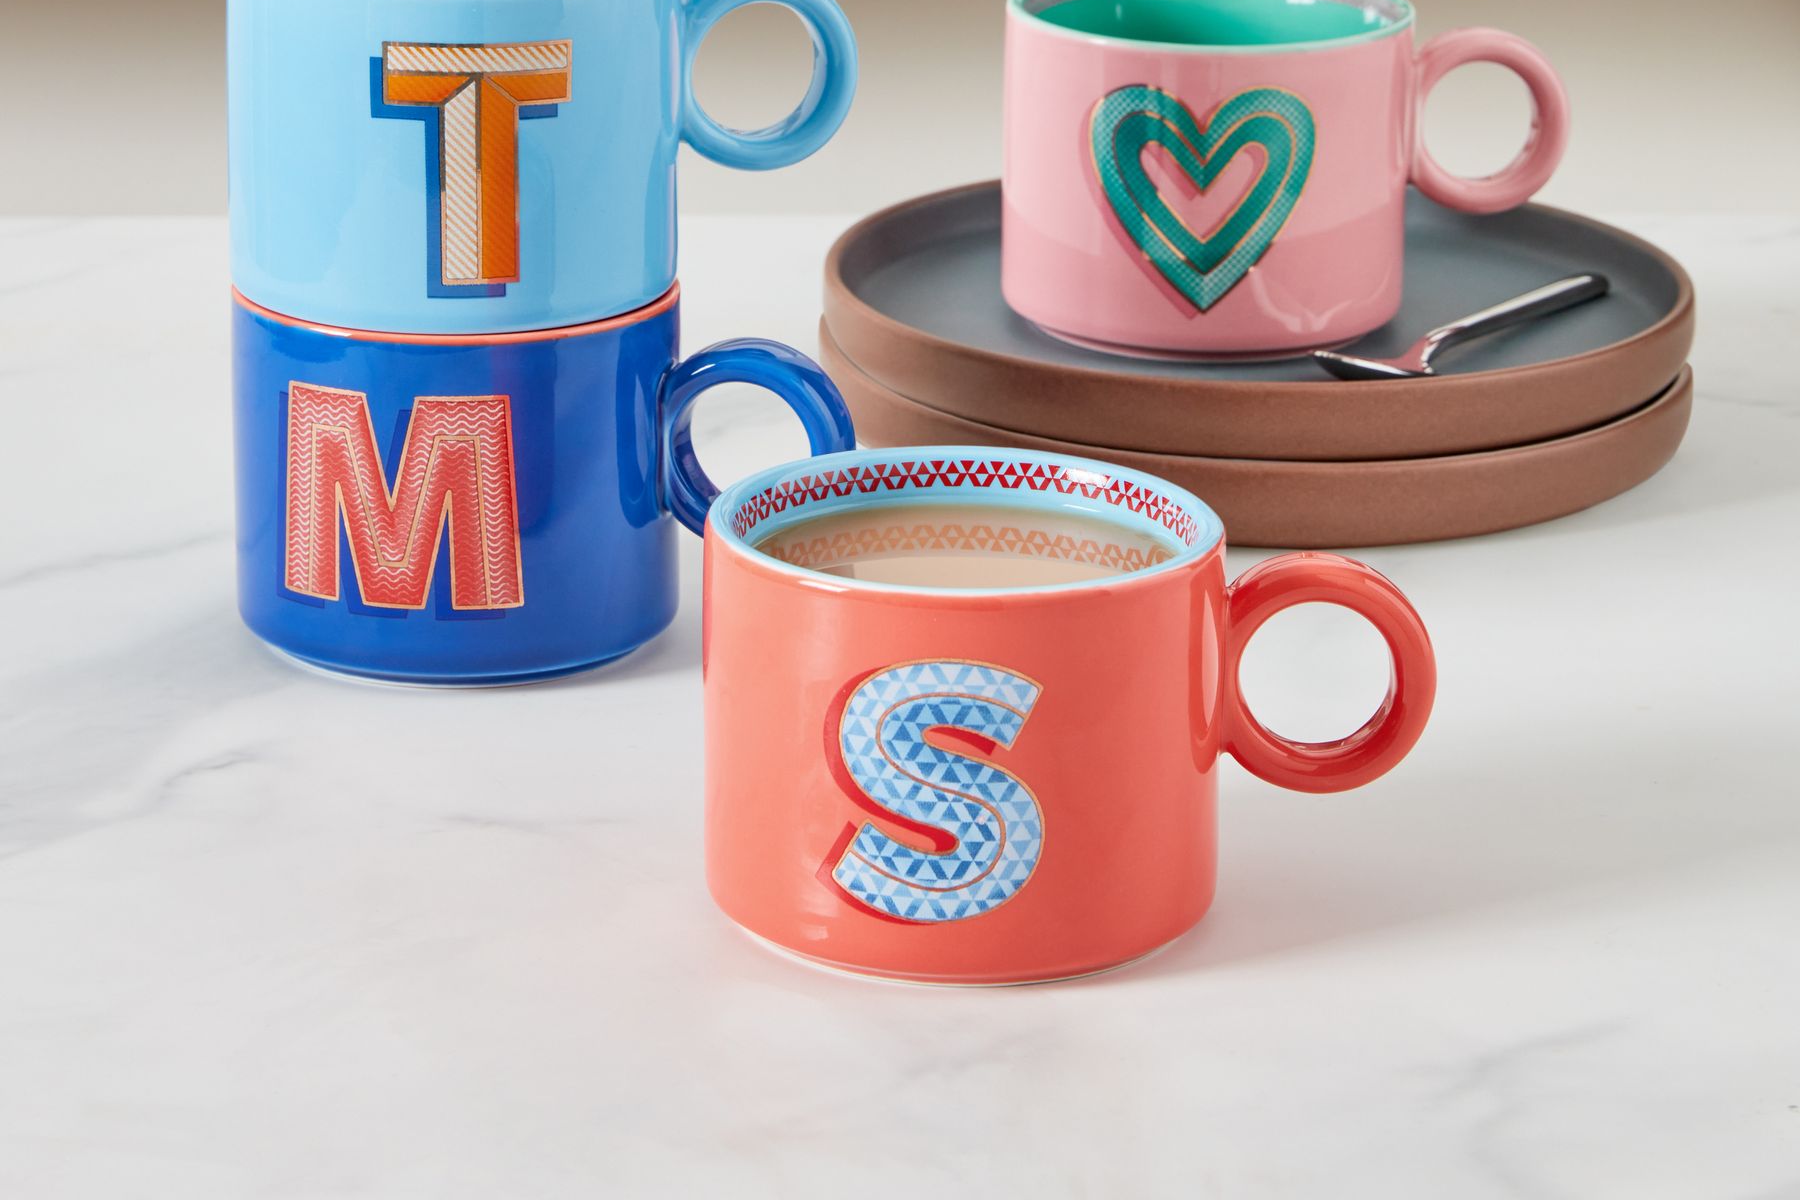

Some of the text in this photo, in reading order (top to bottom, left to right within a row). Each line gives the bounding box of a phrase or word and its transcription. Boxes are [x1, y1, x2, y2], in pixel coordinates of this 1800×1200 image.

[382, 39, 574, 286] T
[285, 380, 525, 611] M
[830, 657, 1046, 924] S
